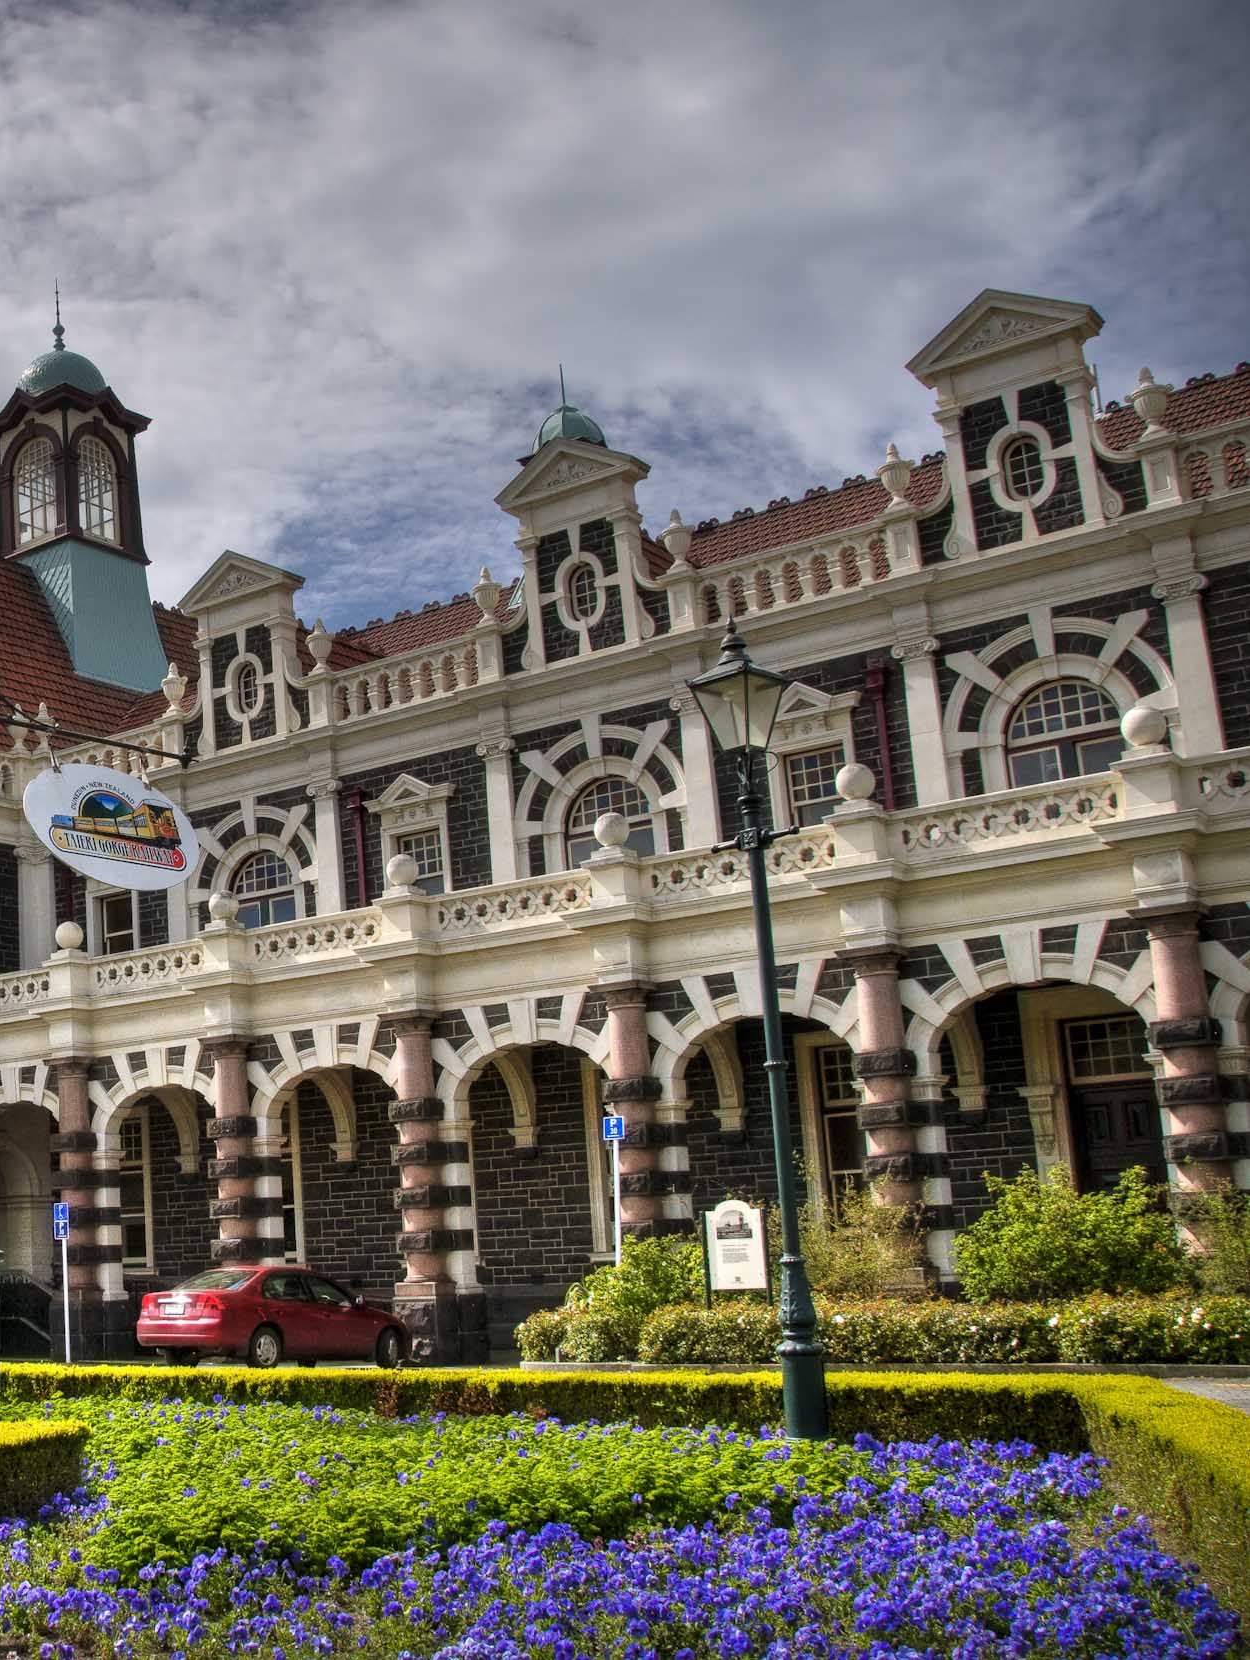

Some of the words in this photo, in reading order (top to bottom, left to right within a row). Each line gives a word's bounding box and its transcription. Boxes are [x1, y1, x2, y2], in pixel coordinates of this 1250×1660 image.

[103, 782, 135, 804] ZEALAND
[64, 832, 97, 852] TAIERI
[98, 839, 130, 857] GORGE
[610, 1118, 617, 1127] P
